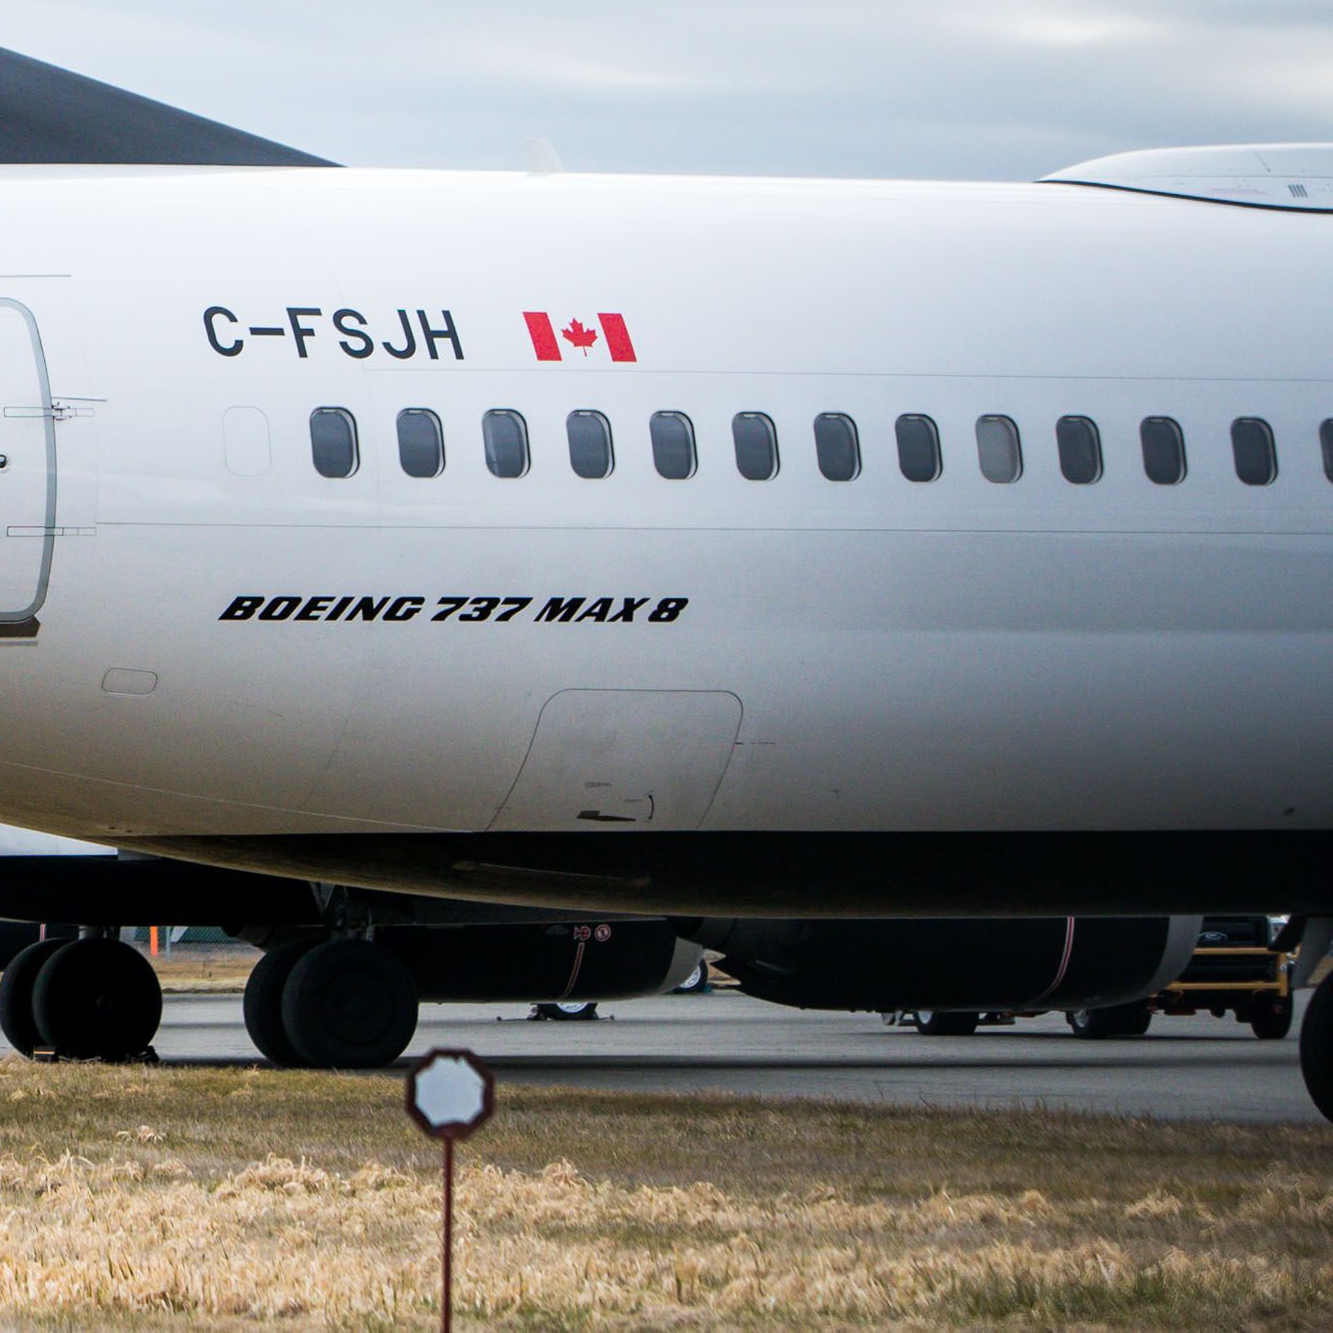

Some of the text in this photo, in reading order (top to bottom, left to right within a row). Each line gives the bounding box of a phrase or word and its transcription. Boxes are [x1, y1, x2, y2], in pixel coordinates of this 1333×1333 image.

[203, 306, 465, 360] C-FSJH
[217, 596, 689, 623] BOEING 737 MAX 8
